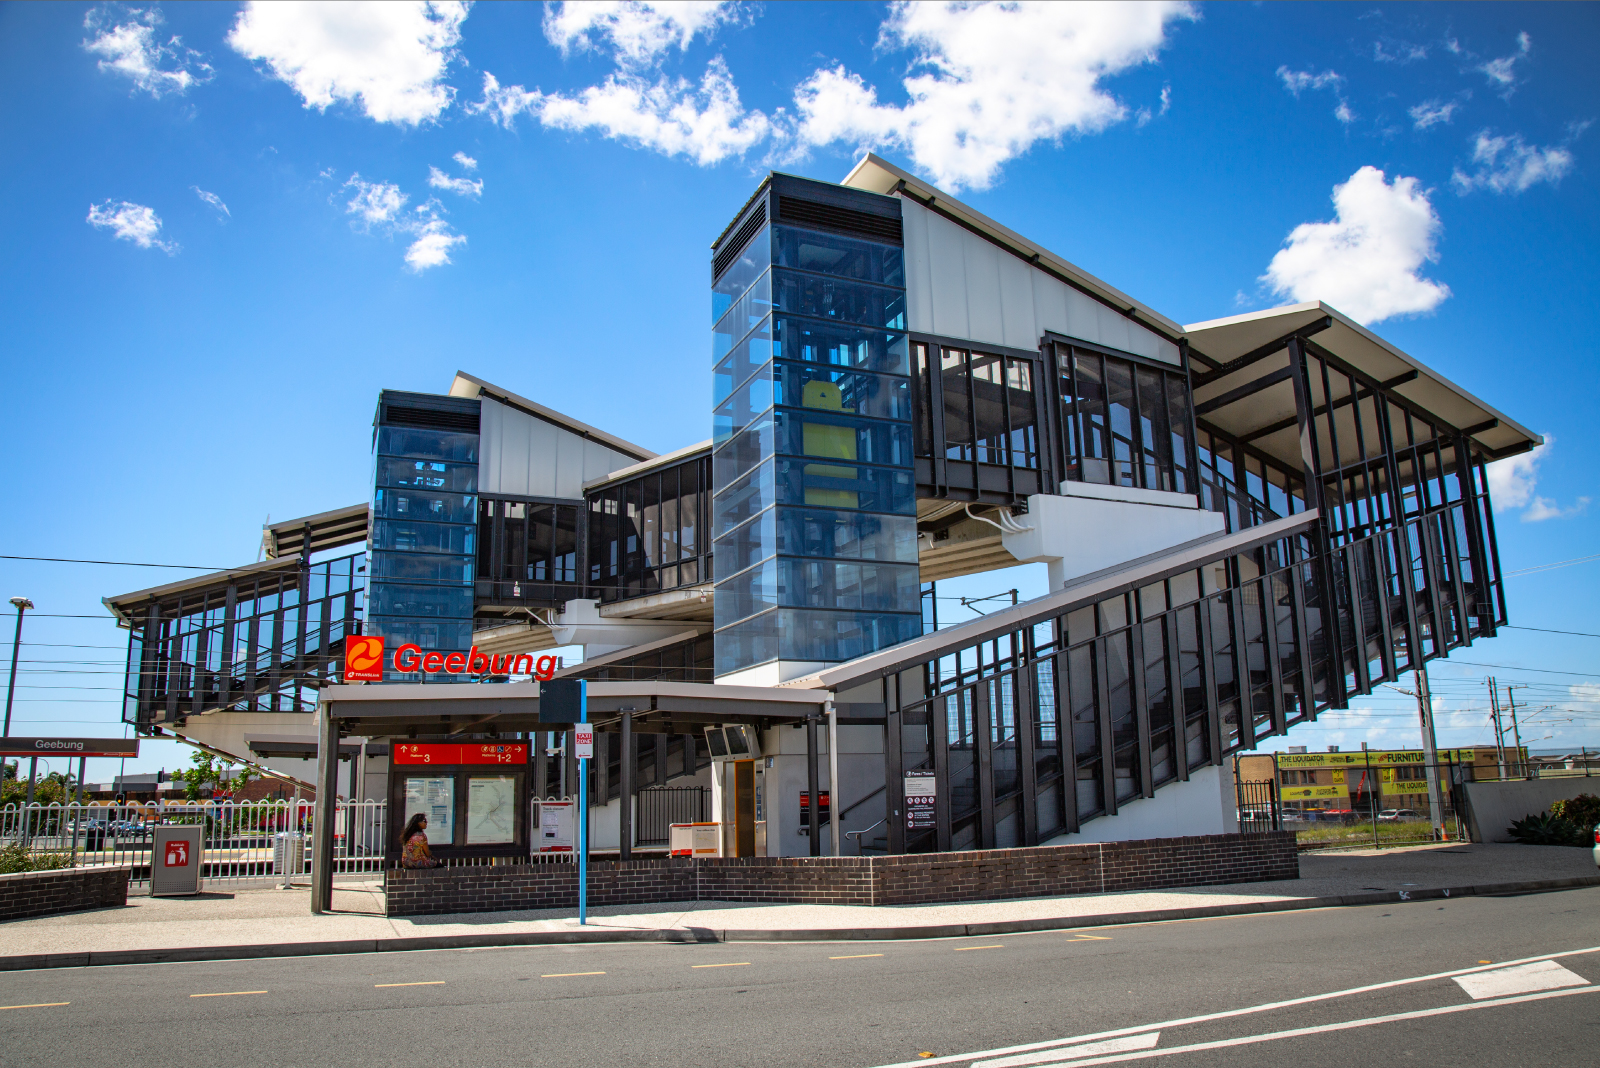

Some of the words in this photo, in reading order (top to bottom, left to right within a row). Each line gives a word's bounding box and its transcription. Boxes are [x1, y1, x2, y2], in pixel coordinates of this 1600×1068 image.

[393, 643, 557, 681] Geebung
[35, 740, 84, 751] Geebung
[424, 754, 431, 763] 3
[497, 754, 511, 763] 1-2
[1293, 754, 1325, 763] LIQUIDATOR
[1387, 753, 1425, 762] FURNITUR
